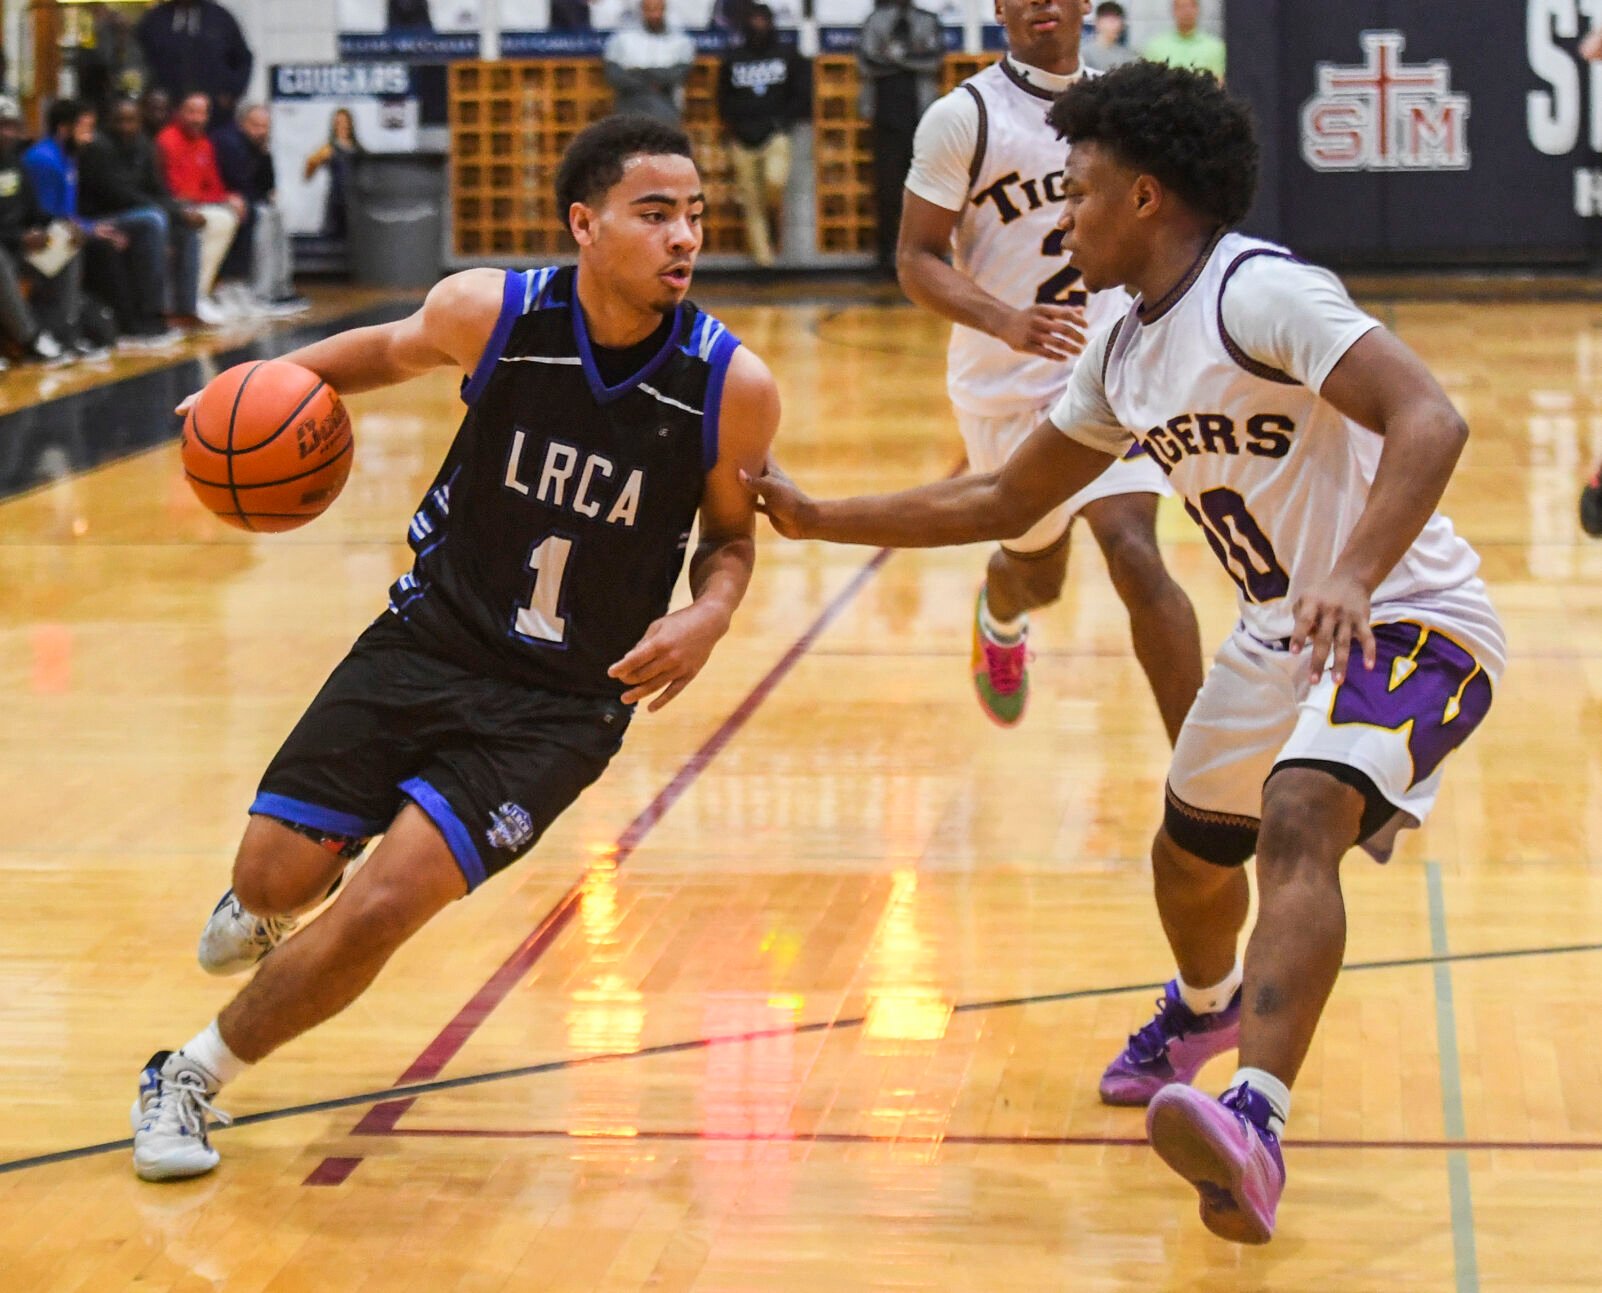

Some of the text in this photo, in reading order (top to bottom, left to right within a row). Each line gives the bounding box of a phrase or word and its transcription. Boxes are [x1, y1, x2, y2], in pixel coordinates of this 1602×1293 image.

[277, 65, 409, 95] COUGARS
[1034, 228, 1088, 306] 2
[504, 430, 643, 527] LRCA
[1141, 412, 1296, 476] IGERS
[514, 535, 573, 642] 1
